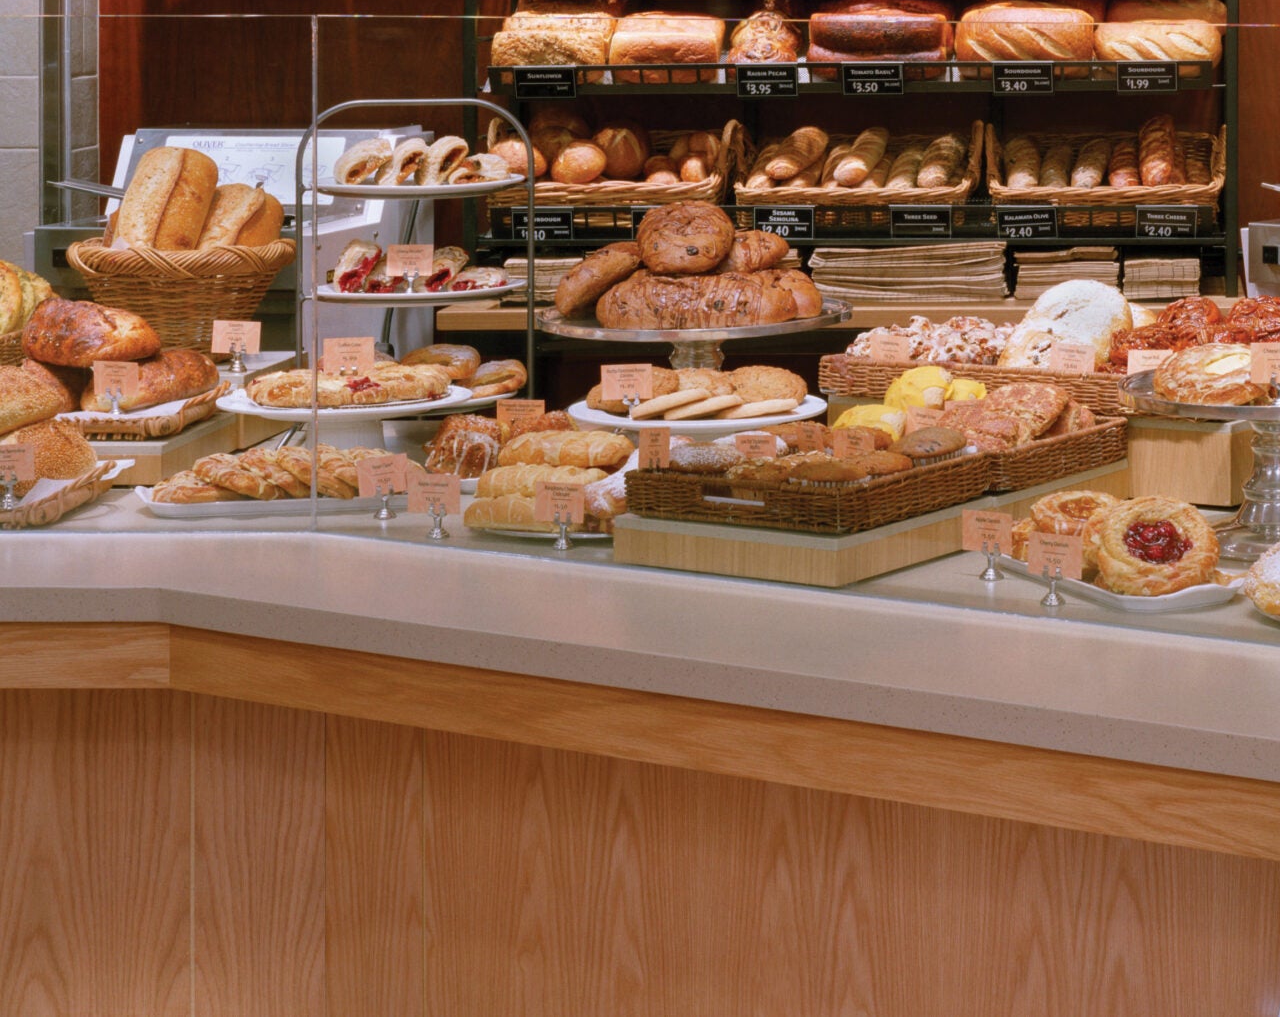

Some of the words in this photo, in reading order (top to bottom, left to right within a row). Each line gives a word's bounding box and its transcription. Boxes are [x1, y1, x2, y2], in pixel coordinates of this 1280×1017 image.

[746, 83, 771, 94] $3.95
[853, 82, 878, 93] $3.50
[1001, 80, 1027, 91] $3.40
[1126, 78, 1149, 89] $1.99
[1004, 214, 1032, 222] KALAMATA
[762, 225, 789, 236] $240
[1005, 226, 1032, 238] $2.40
[1145, 225, 1172, 236] $2.40
